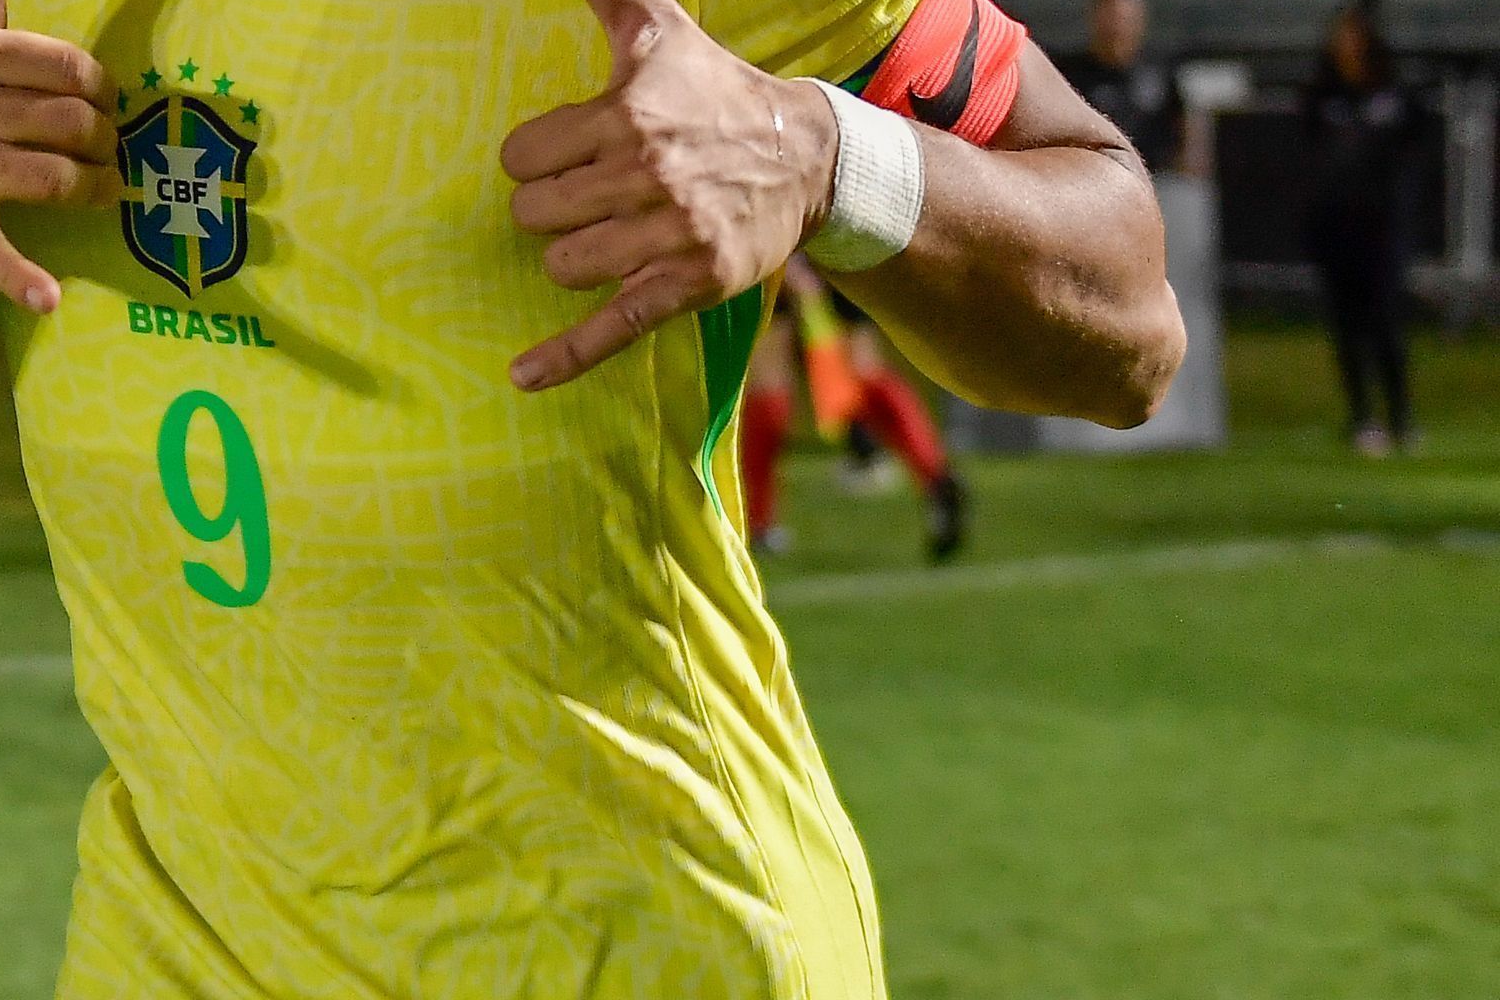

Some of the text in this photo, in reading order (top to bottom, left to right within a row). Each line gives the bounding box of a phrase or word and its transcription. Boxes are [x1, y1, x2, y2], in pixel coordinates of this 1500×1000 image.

[156, 178, 208, 205] CBF
[127, 301, 275, 348] BRASIL
[157, 390, 272, 608] 9
